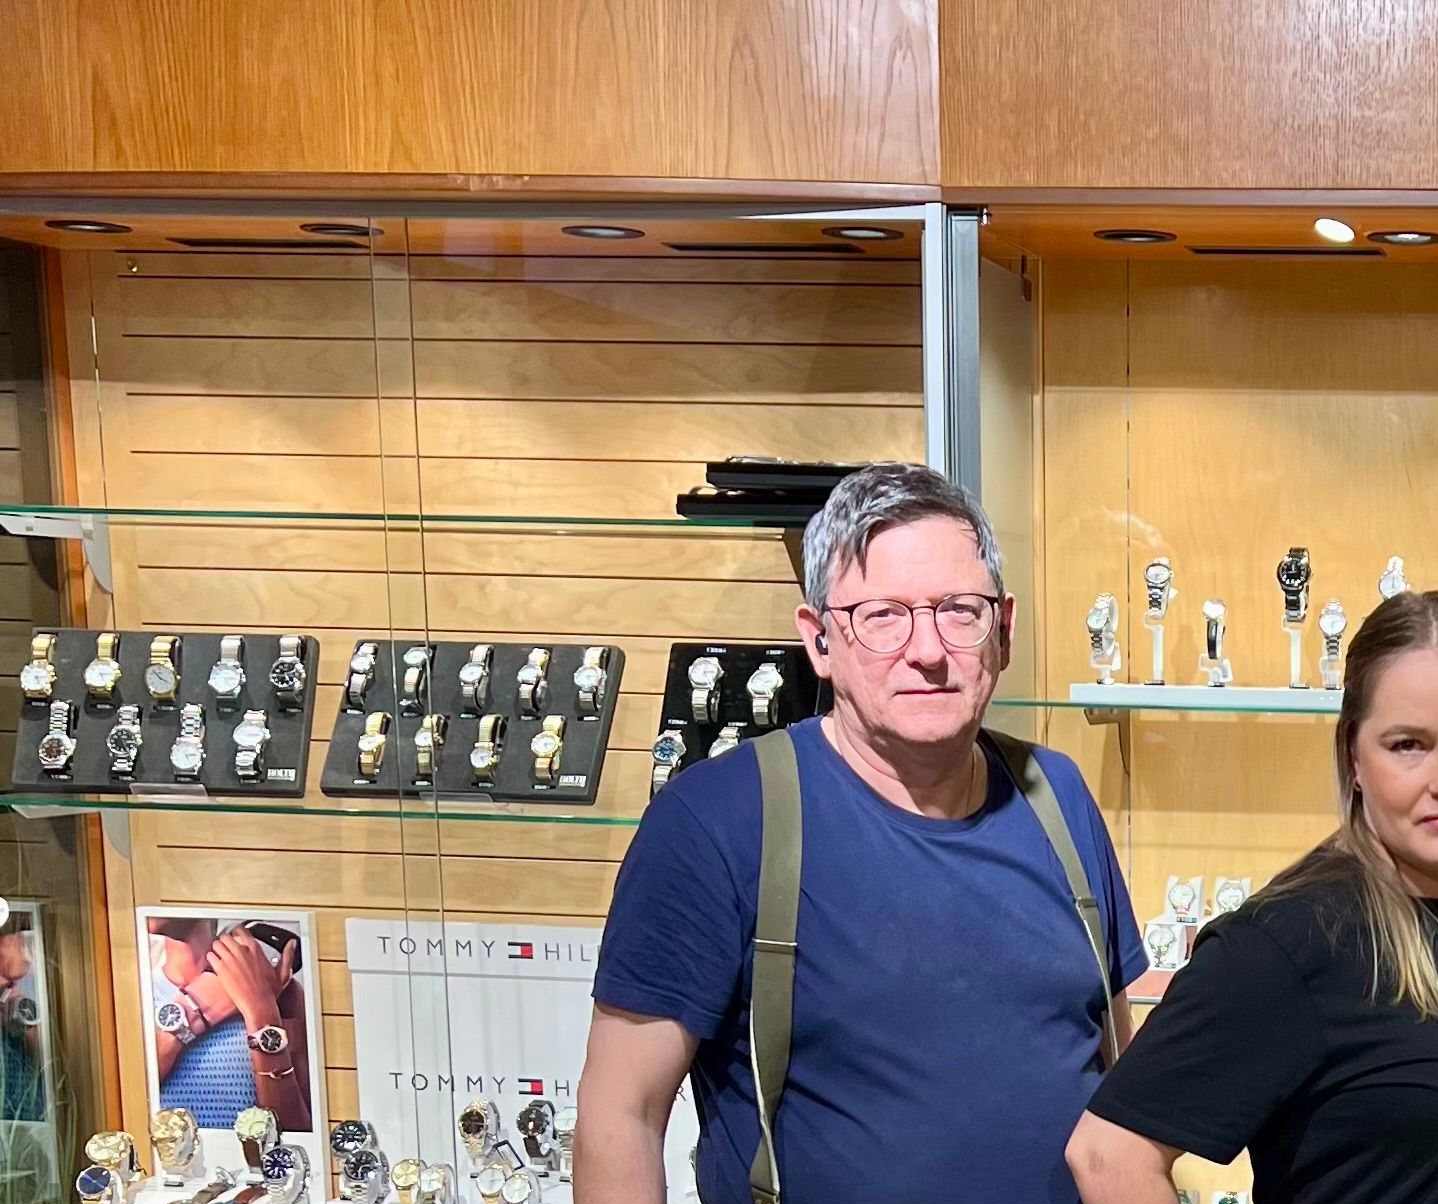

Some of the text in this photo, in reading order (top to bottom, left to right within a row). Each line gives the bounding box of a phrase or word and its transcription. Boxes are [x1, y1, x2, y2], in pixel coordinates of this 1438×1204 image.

[376, 935, 602, 963] TOMMY HIL
[389, 1072, 506, 1094] TOMMY
